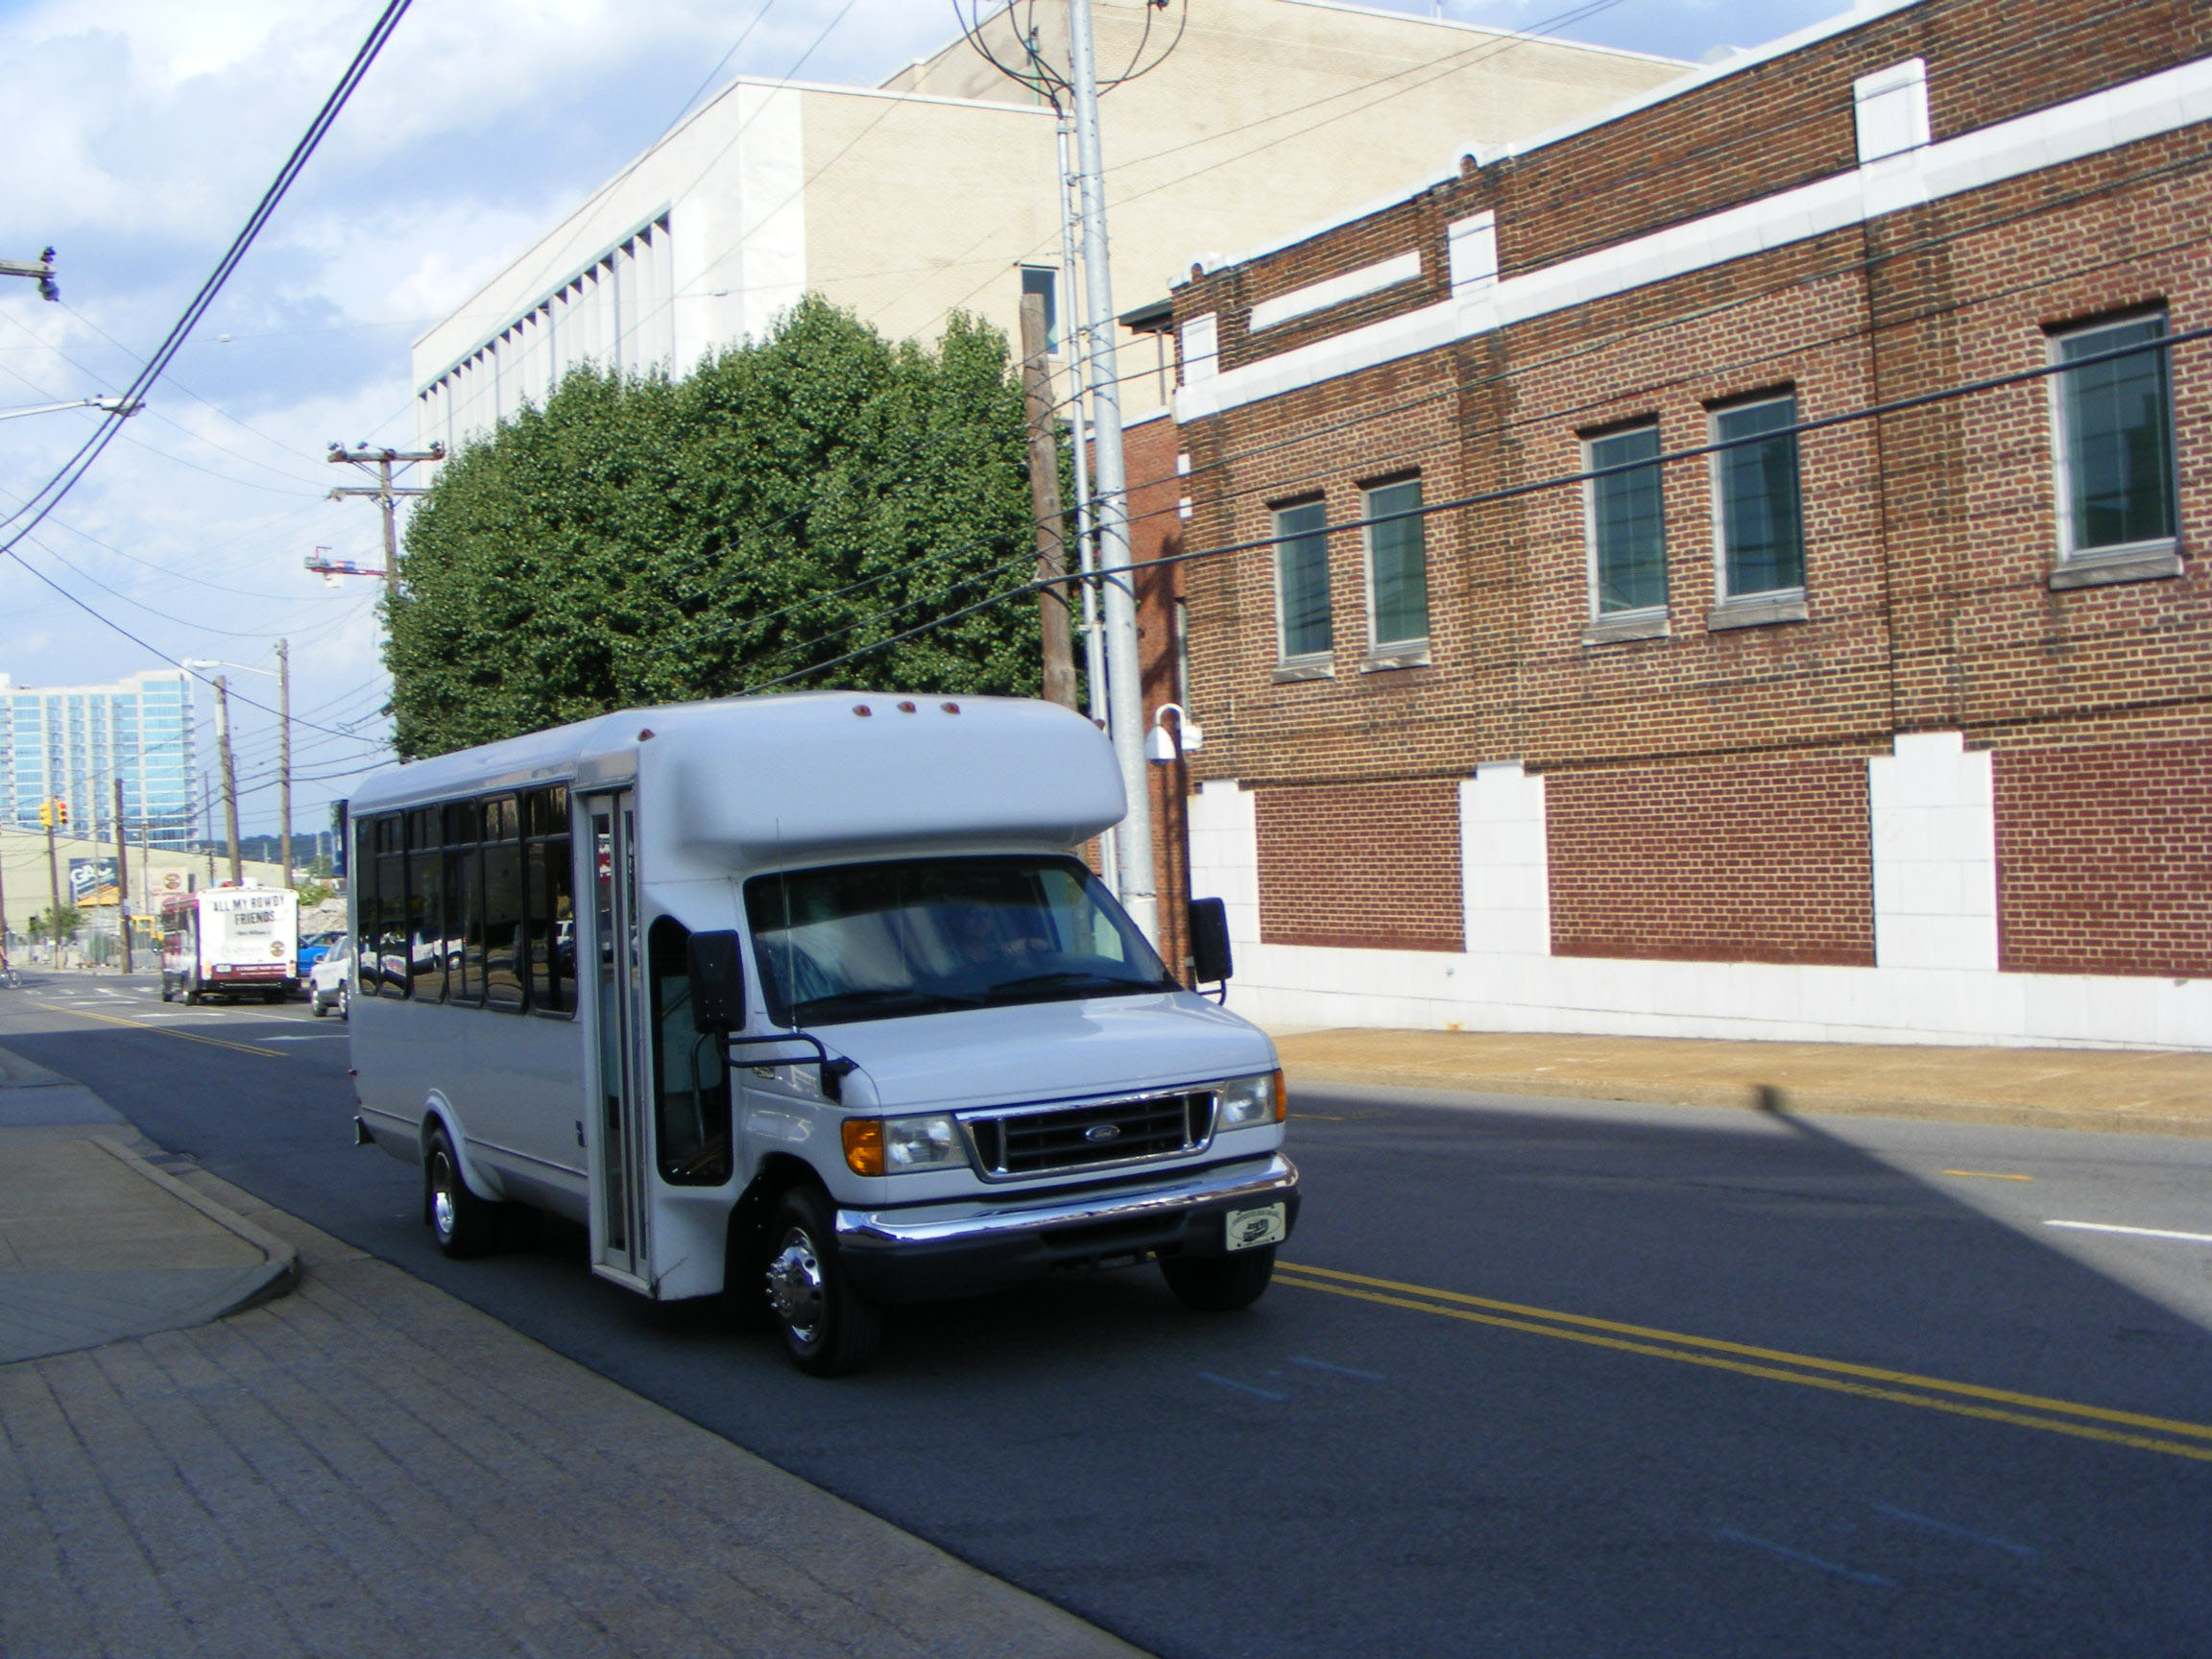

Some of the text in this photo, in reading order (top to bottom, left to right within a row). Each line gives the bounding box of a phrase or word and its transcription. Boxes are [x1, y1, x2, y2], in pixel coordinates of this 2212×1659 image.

[232, 899, 248, 911] MY
[251, 895, 284, 908] ROWDY
[234, 910, 276, 926] FRIENDS
